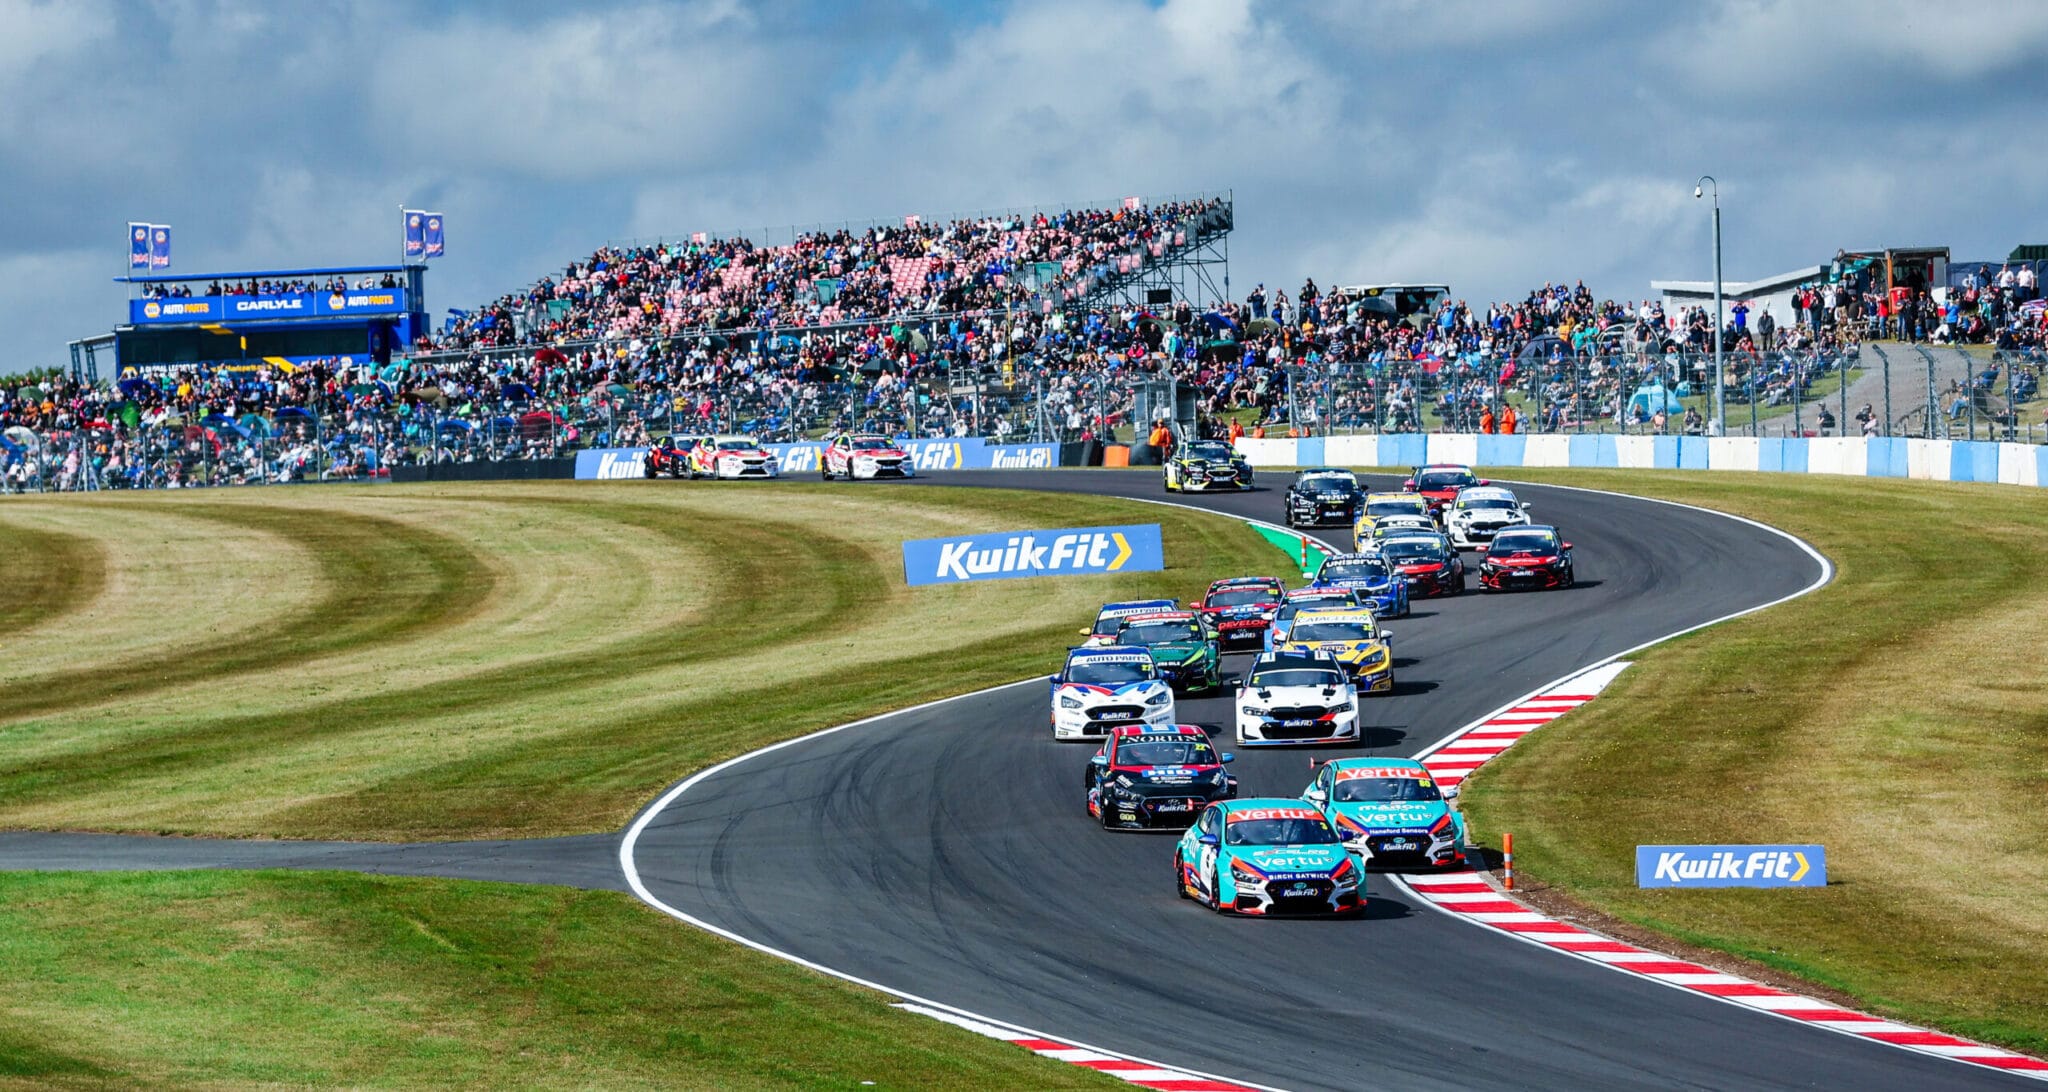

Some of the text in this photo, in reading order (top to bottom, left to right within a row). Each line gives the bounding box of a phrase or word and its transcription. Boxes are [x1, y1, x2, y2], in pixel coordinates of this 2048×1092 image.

[237, 299, 302, 311] CARLYLE
[347, 296, 368, 307] AUTO
[163, 304, 183, 314] AUTO
[1127, 735, 1198, 743] NORLIN
